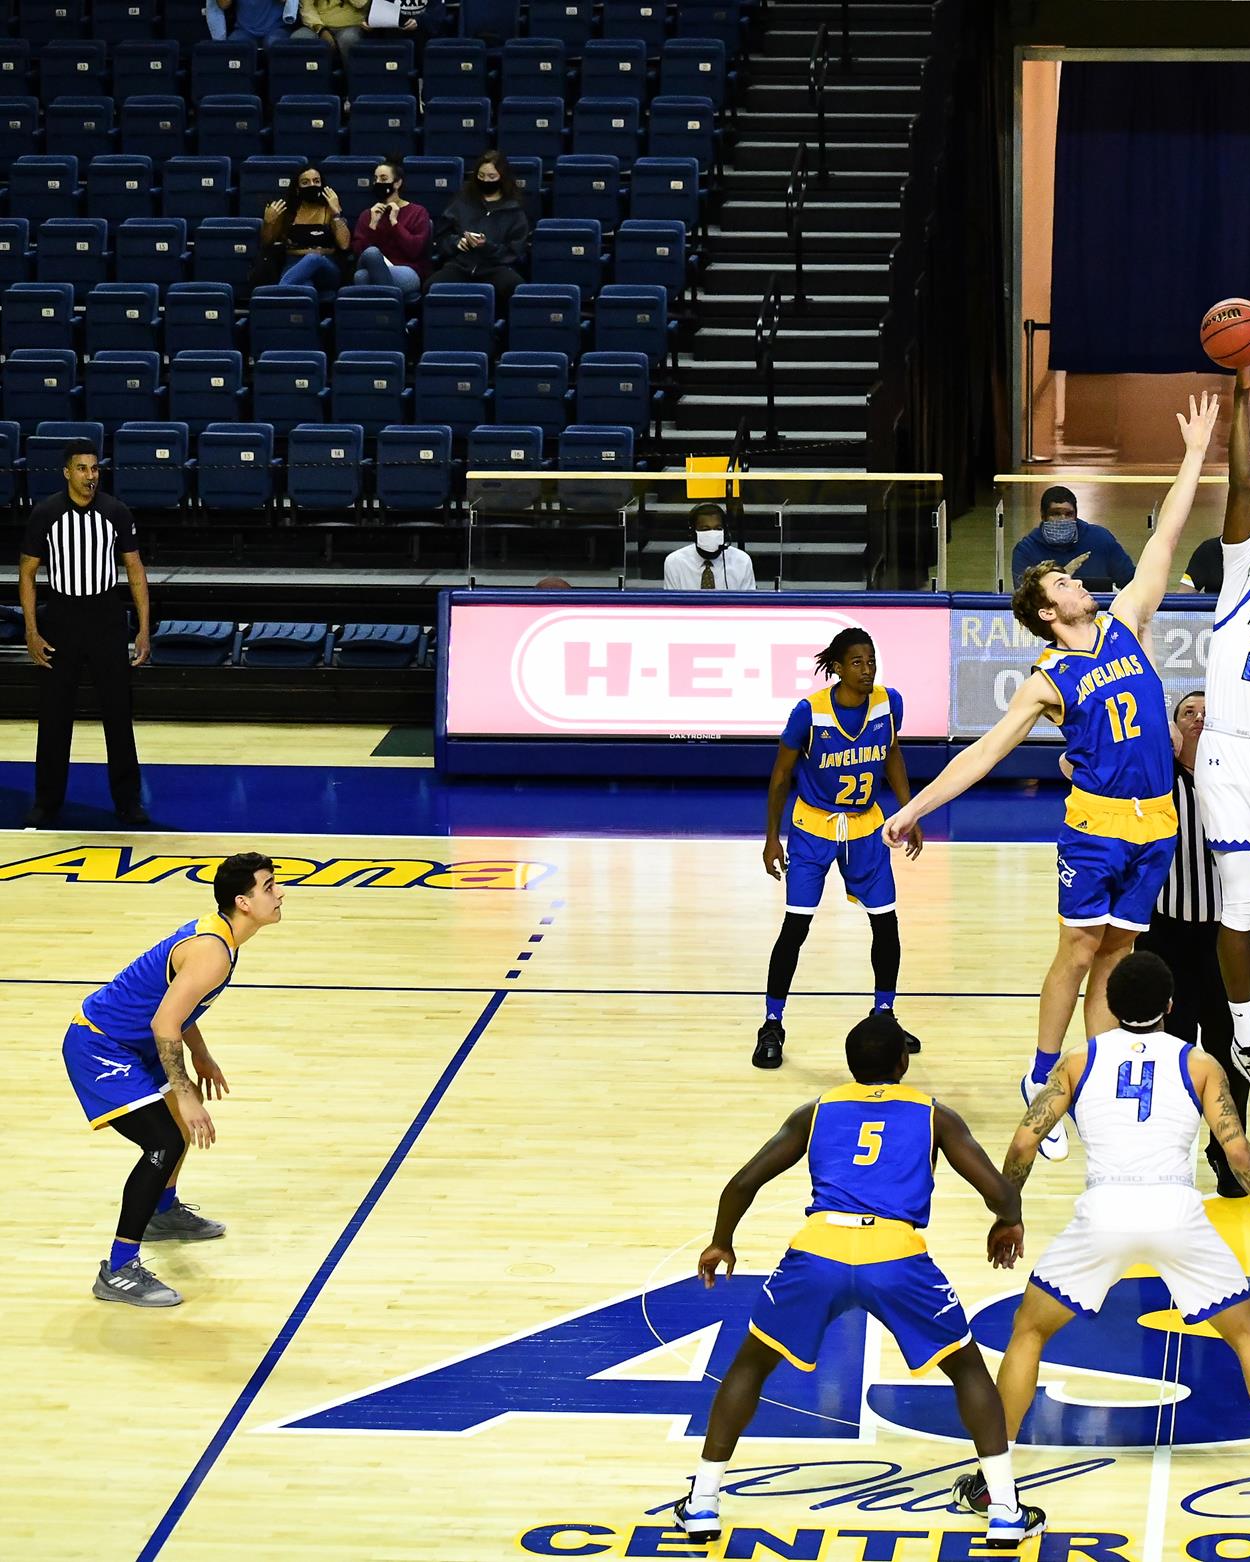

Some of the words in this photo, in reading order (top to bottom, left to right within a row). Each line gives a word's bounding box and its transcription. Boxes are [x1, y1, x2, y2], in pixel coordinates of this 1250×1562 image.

[1076, 654, 1145, 706] JAVELINAS
[1104, 691, 1142, 744] 12
[819, 744, 887, 769] JAVELINAS
[835, 771, 874, 806] 23
[1115, 1060, 1156, 1123] 4
[852, 1120, 886, 1167] 5
[518, 1523, 1132, 1562] CENTER
